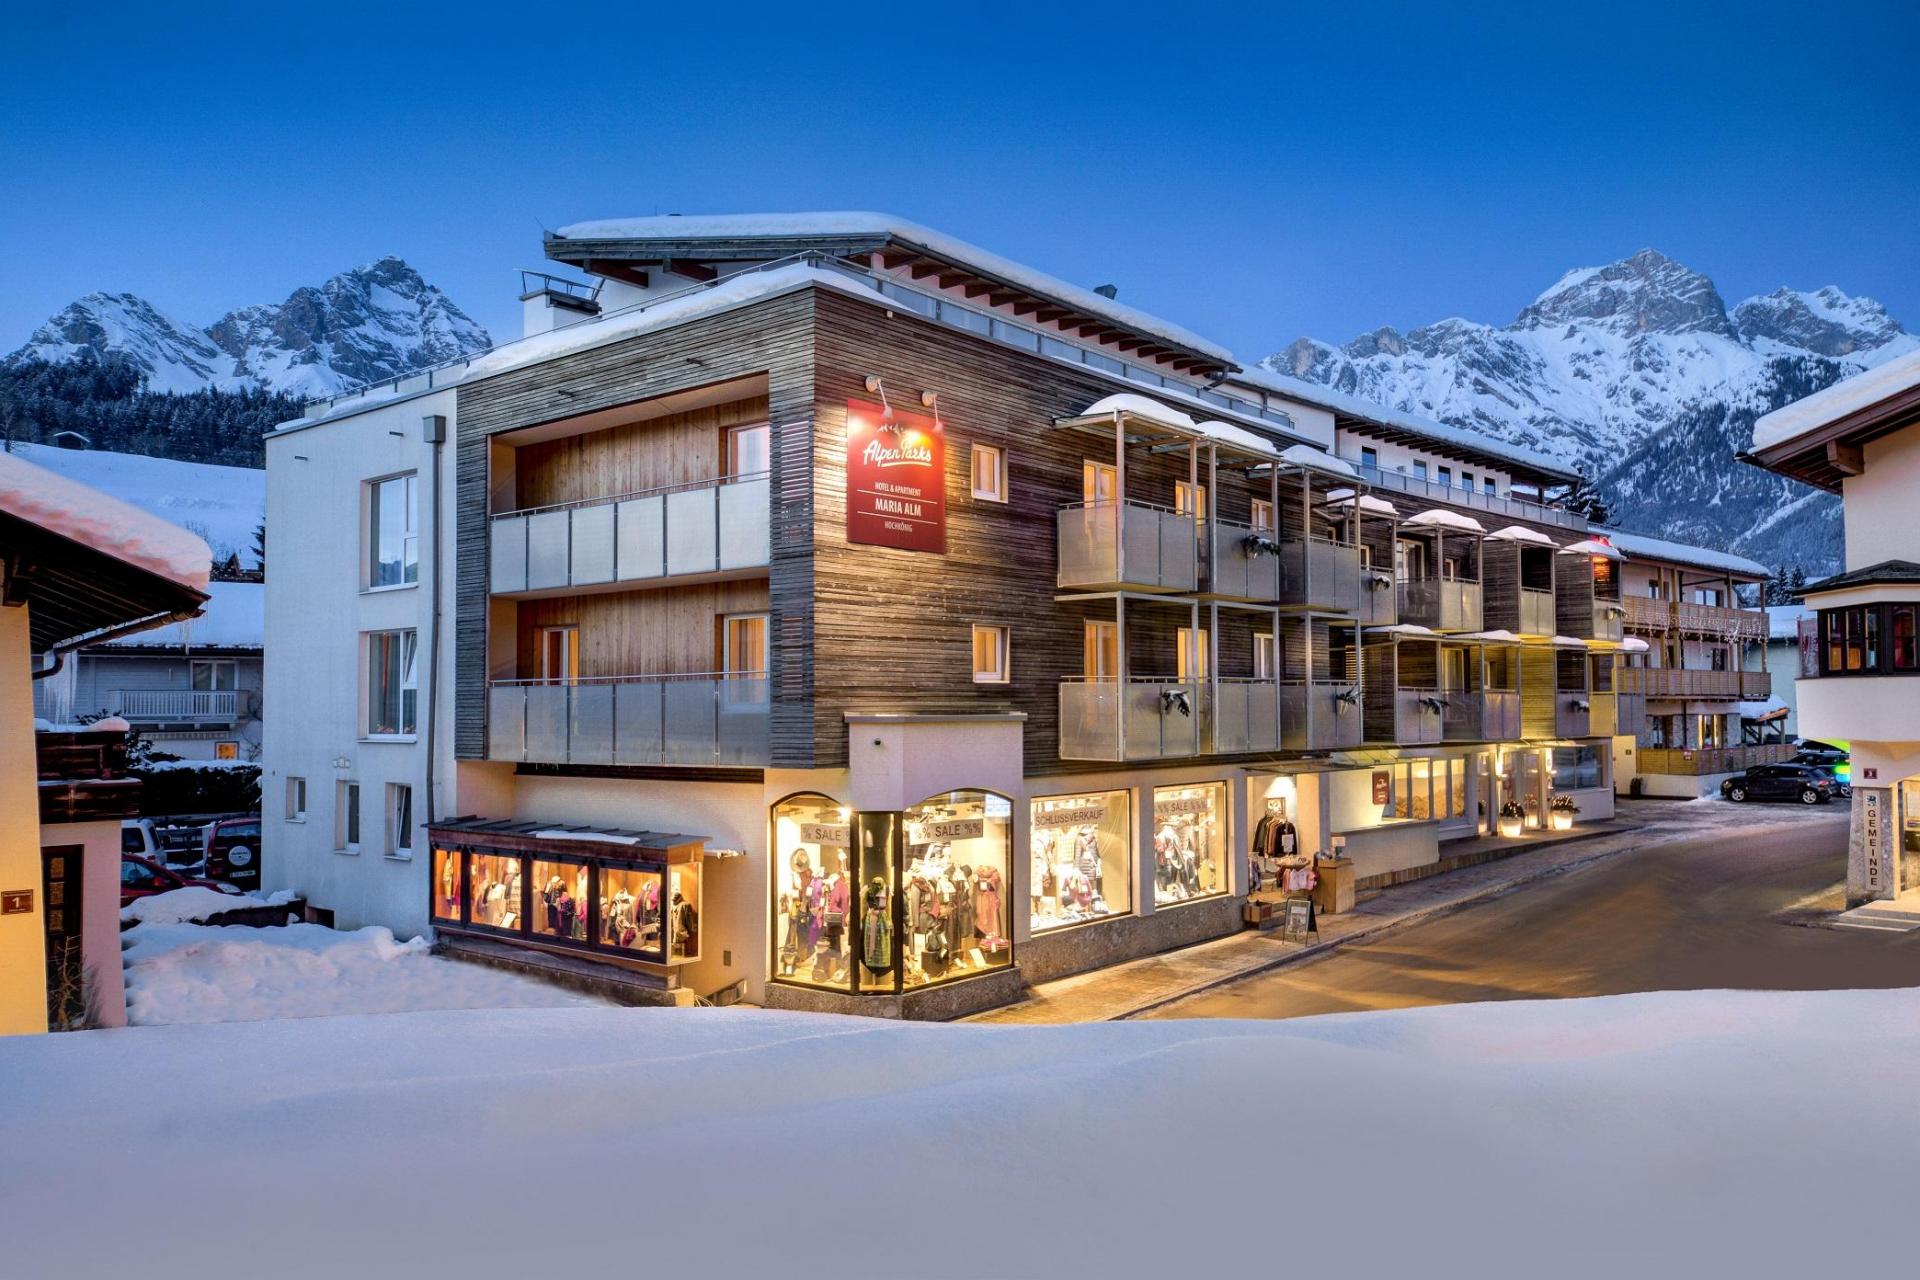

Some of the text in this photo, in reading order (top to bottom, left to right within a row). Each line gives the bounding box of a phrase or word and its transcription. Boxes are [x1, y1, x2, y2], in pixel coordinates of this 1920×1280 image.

[875, 482, 921, 497] HOTEL & APARTMENT
[875, 498, 921, 517] MARIA ALM
[885, 521, 912, 532] HOCHKÖNIG
[1171, 801, 1188, 812] SALE
[1035, 809, 1104, 826] SCHLUSSVERKAUF
[815, 828, 841, 841] SALE
[935, 824, 961, 837] SALE
[1867, 809, 1878, 886] GEMEINDE
[12, 897, 20, 909] 1
